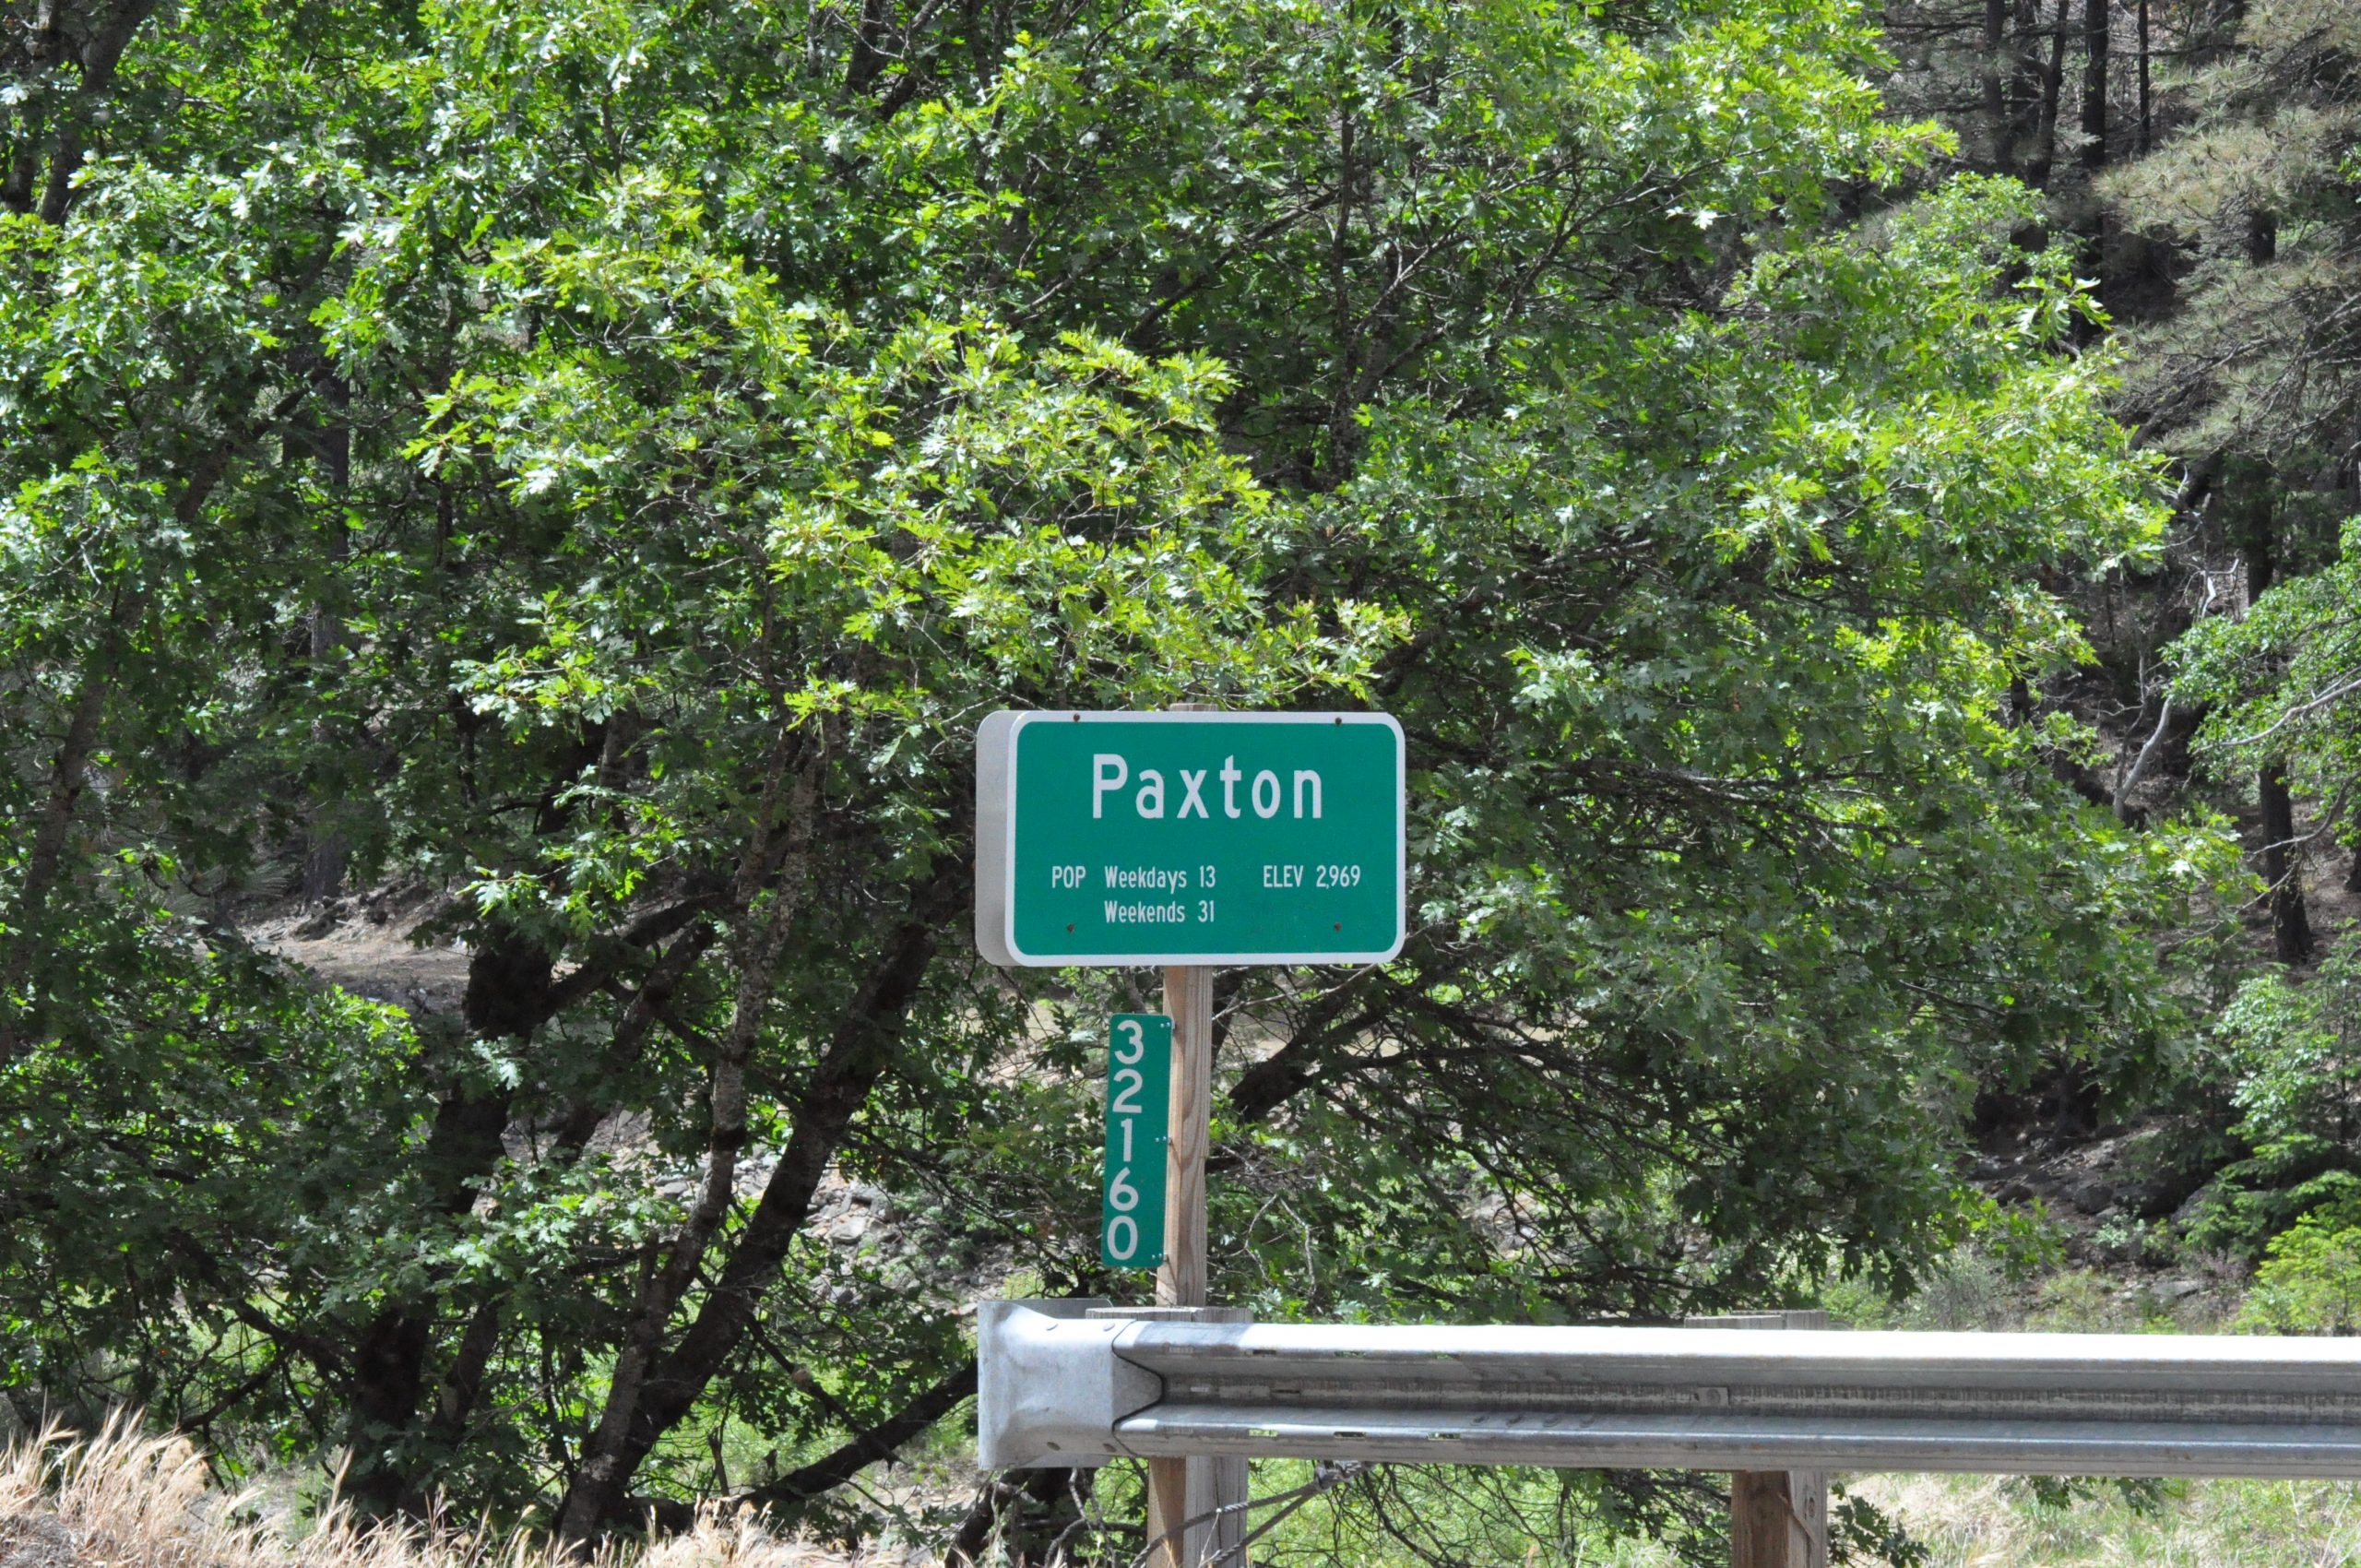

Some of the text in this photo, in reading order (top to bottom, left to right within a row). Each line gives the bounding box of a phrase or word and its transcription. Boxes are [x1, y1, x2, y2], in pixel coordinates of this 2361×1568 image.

[1093, 753, 1323, 819] Paxton
[1051, 864, 1361, 894] POP Weekdays 13 ELEV 2,969
[1104, 900, 1216, 923] Weekends 31
